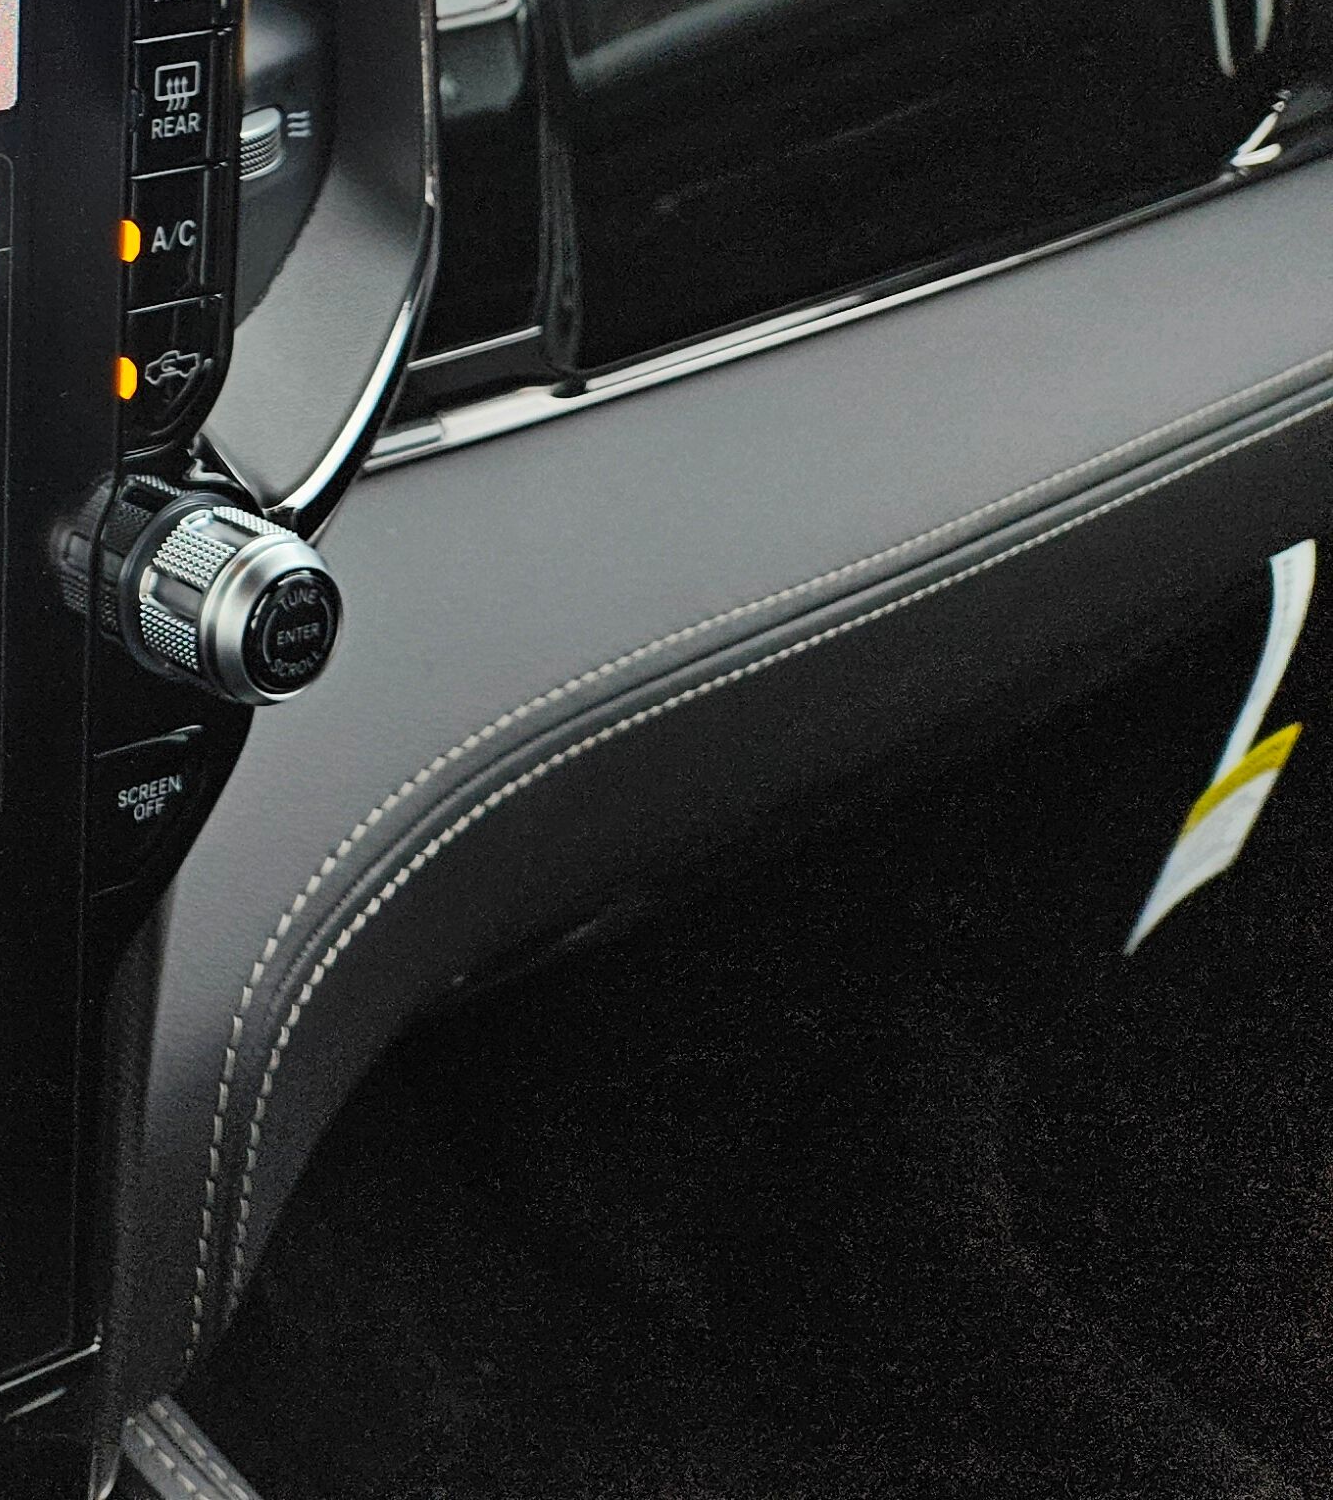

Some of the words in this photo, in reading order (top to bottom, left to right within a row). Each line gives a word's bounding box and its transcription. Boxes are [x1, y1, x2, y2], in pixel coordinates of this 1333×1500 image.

[151, 114, 200, 140] REAR
[151, 219, 197, 253] A/C
[279, 588, 319, 612] TUNE
[276, 622, 319, 646] ENTER
[117, 774, 183, 810] SCREEN
[133, 797, 165, 821] OFF
